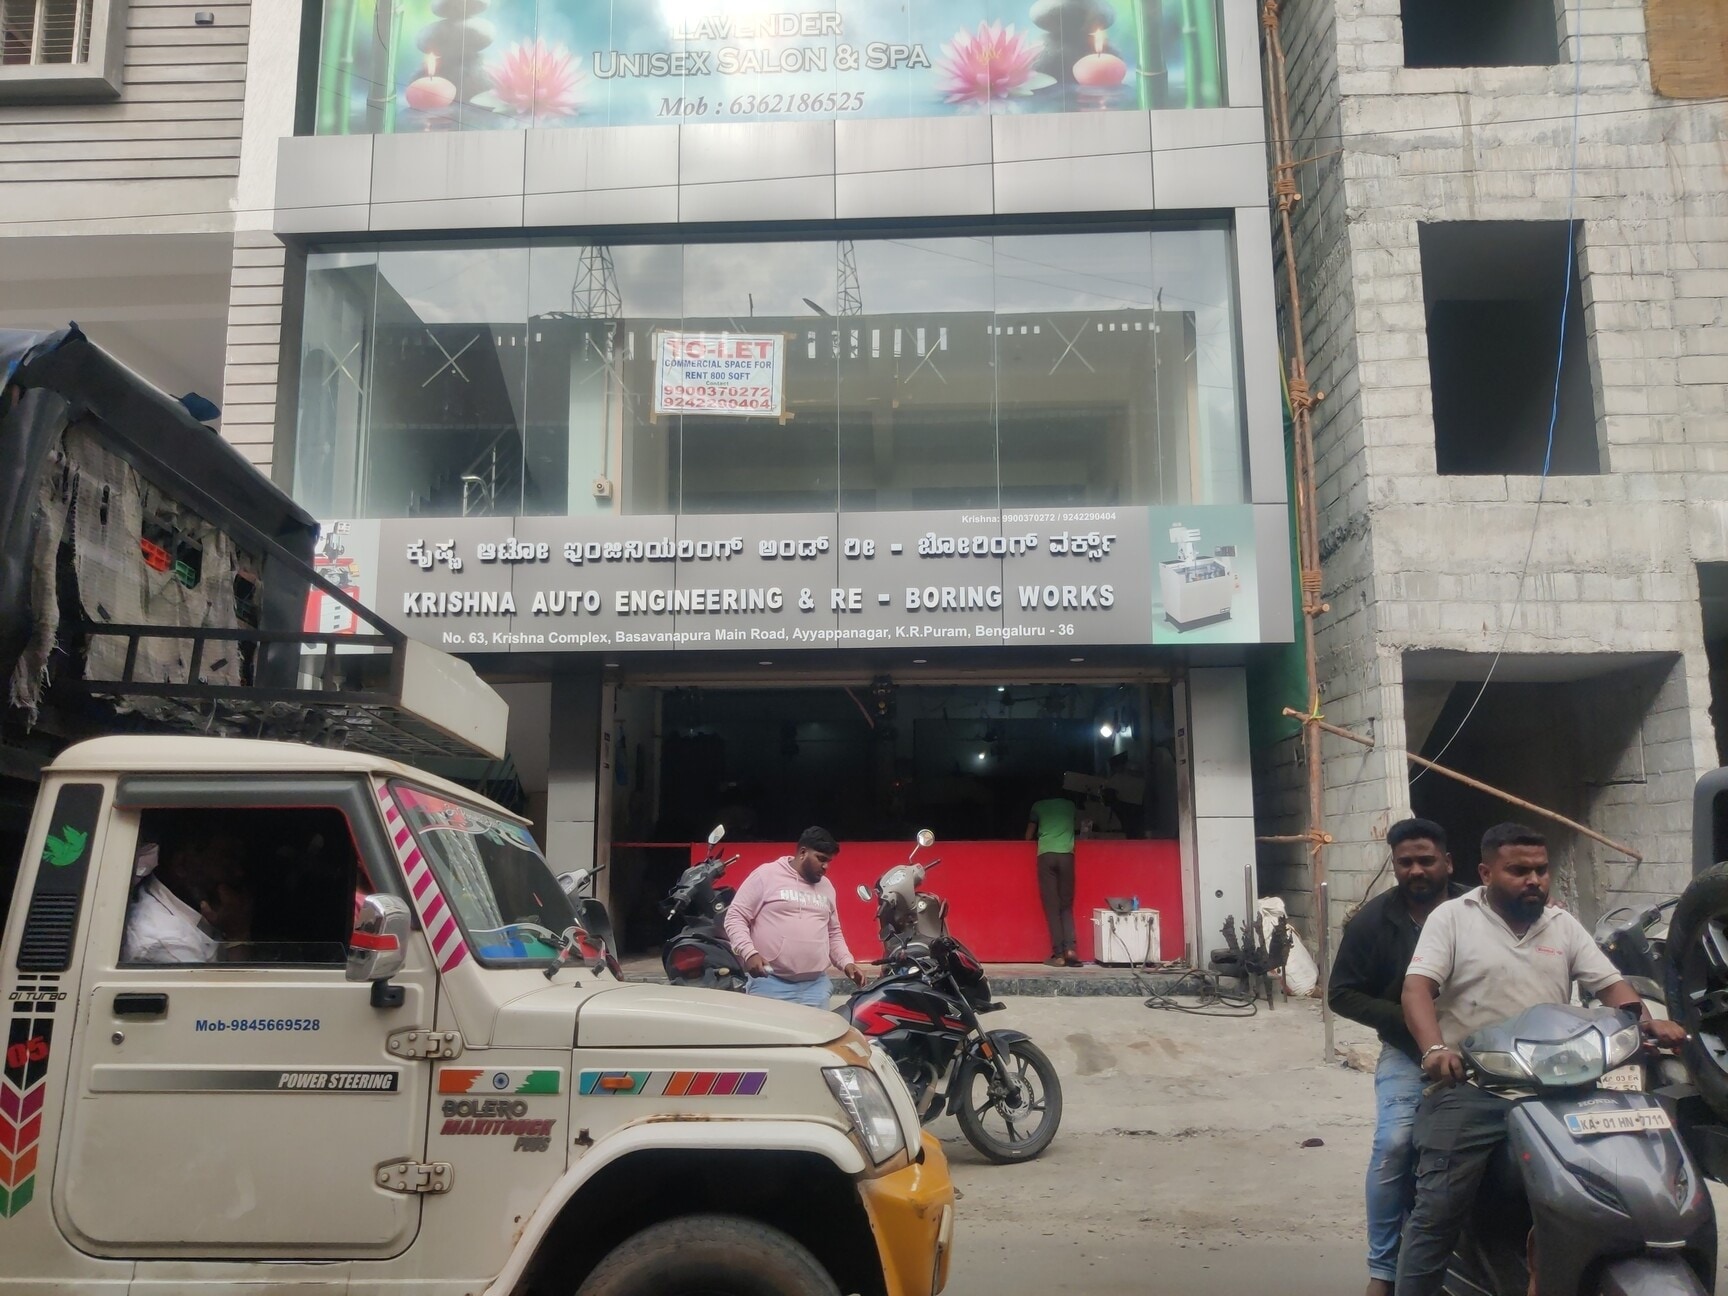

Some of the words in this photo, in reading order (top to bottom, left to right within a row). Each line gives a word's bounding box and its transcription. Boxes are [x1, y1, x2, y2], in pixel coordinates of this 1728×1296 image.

[672, 11, 844, 41] LAVENDER
[833, 43, 860, 71] &
[656, 96, 709, 117] Mob
[729, 91, 865, 115] 6362186525
[664, 359, 722, 368] COMMERCIAL
[724, 360, 752, 369] SPACE
[754, 361, 772, 369] FOR
[685, 371, 709, 380] RENT
[710, 371, 726, 380] 800
[728, 372, 751, 381] SQFT
[961, 514, 1000, 524] Krishna:
[1002, 513, 1056, 523] 9900370272
[1062, 512, 1117, 522] 9242290404
[406, 538, 464, 574] ಕೃಷ್ಣ
[476, 537, 550, 563] ಆಟೋ
[758, 535, 831, 559] ಅಂಡ್
[918, 531, 1039, 557] ಬೋರಿಂಗ್
[403, 591, 517, 616] KRISHNA
[531, 589, 602, 614] AUTO
[614, 586, 784, 613] ENGINEERING
[798, 587, 815, 611] &
[830, 587, 864, 611] RE
[905, 585, 1003, 610] BORING
[1018, 584, 1116, 608] WORKS
[442, 631, 465, 644] No.
[468, 632, 489, 645] 63,
[492, 631, 545, 644] Krishna
[548, 631, 611, 646] Complex,
[615, 629, 711, 643] Basavanapura
[715, 627, 747, 641] Main
[750, 627, 789, 642] Road,
[792, 627, 892, 642] Ayyappanagar,
[895, 624, 971, 640] K.R.Puram,
[975, 623, 1046, 640] Bengaluru
[1058, 624, 1075, 637] 36
[195, 1019, 321, 1032] Mob-9845669528
[278, 1073, 327, 1089] POWER
[328, 1073, 394, 1090] STEERING
[441, 1100, 528, 1119] BOLERO
[440, 1119, 557, 1136] MAXITRUCK
[1581, 1118, 1597, 1130] KA
[1603, 1118, 1616, 1129] 01
[1619, 1117, 1634, 1128] HN
[513, 1136, 552, 1153] PLUS
